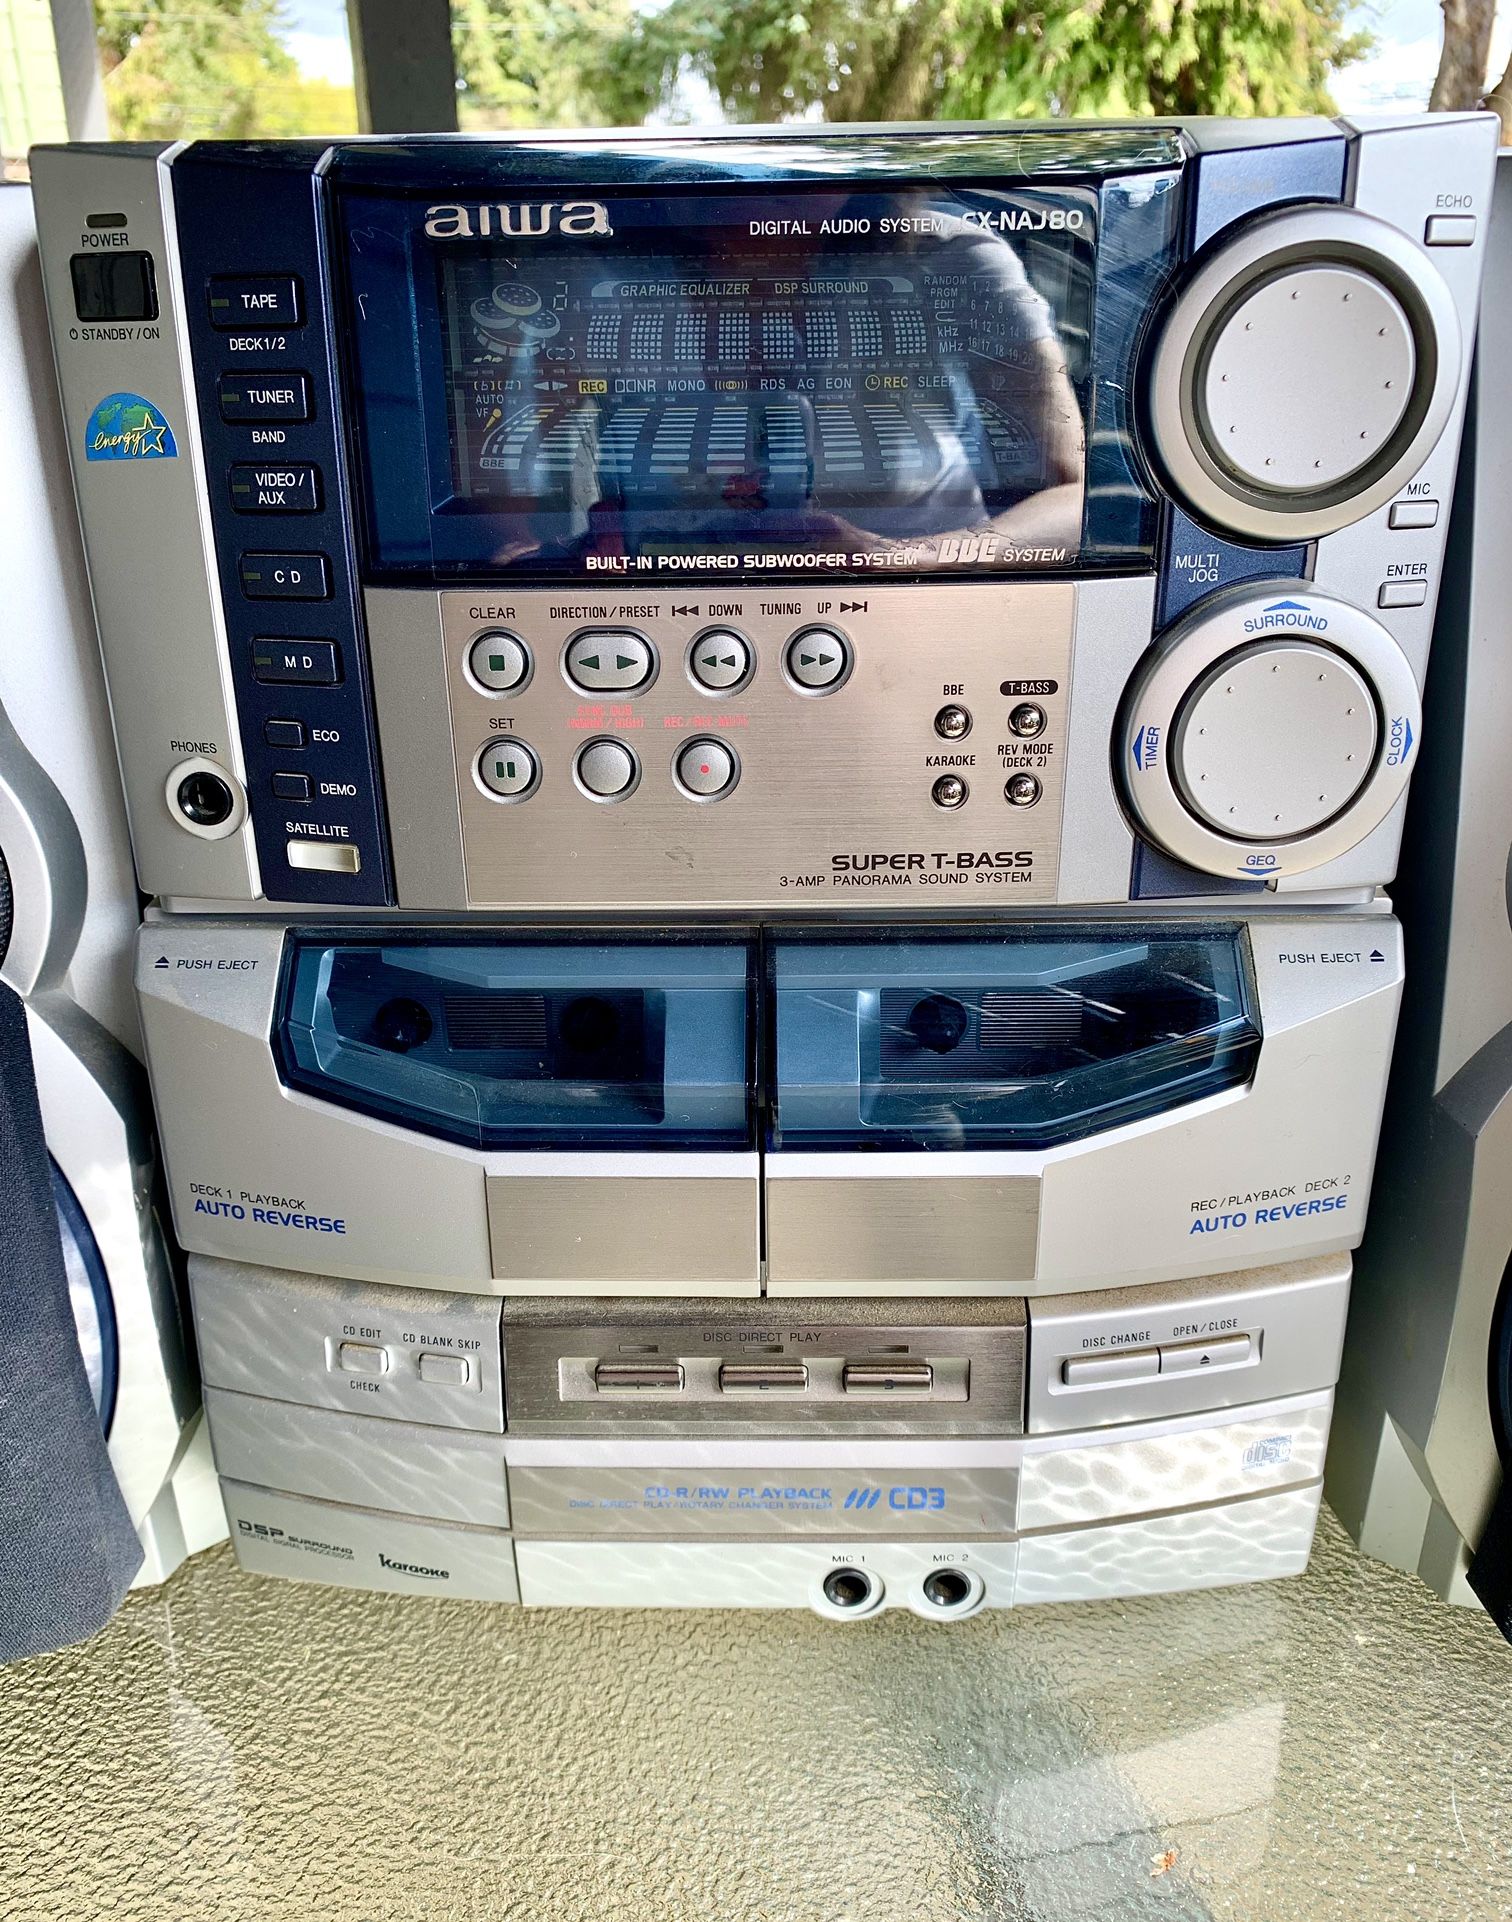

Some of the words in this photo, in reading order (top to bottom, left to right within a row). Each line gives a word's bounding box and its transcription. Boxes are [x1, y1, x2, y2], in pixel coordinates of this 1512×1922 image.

[1436, 194, 1473, 208] ECHO
[424, 201, 614, 239] aiwa
[749, 220, 812, 237] DIGITAL
[819, 218, 871, 235] AUDIO
[879, 217, 944, 233] SYSTEM
[81, 233, 130, 247] POWER
[923, 275, 967, 285] RANDOM
[620, 284, 677, 297] GRAPHIC
[680, 283, 751, 296] EQUALIZER
[774, 283, 799, 294] DSP
[801, 281, 869, 294] SURROUND
[930, 287, 958, 297] PRGM
[241, 294, 278, 309] TAPE
[934, 299, 955, 309] EDIT
[937, 326, 959, 338] kHz
[938, 341, 964, 354] MHz
[581, 381, 605, 393] REC
[667, 380, 706, 392] MONO
[760, 378, 786, 390] RDS
[797, 378, 815, 390] AG
[825, 377, 852, 389] EON
[883, 376, 909, 388] REC
[918, 375, 957, 388] SLEEP
[247, 389, 295, 404] TUNER
[475, 394, 504, 405] AUTO
[475, 407, 488, 418] VF
[252, 430, 286, 444] BAND
[482, 459, 505, 468] BBE
[1407, 482, 1431, 496] MIC
[258, 491, 286, 505] AUX
[938, 538, 1001, 563] BBE
[1003, 548, 1067, 562] SYSTEM
[585, 555, 653, 570] BUILT-IN
[657, 555, 739, 569] POWERED
[743, 553, 847, 569] SUBWOOFER
[851, 552, 918, 566] SYSTEM
[1175, 554, 1220, 569] MULTI
[1188, 569, 1219, 583] JOG
[1386, 563, 1428, 577] ENTER
[469, 607, 516, 620] CLEAR
[708, 604, 743, 617] DOWN
[760, 603, 802, 616] TUNING
[817, 602, 832, 614] UP
[1243, 613, 1329, 633] SURROUND
[942, 684, 965, 696] BBE
[1008, 682, 1050, 694] T-BASS
[488, 717, 516, 730] SET
[312, 729, 340, 743] ECO
[1386, 716, 1403, 766] CLOCK
[170, 740, 218, 754] PHONES
[997, 744, 1019, 755] REV
[1022, 743, 1054, 755] MODE
[1145, 726, 1161, 770] TIMER
[926, 754, 976, 767] KARAOKE
[1002, 756, 1033, 769] (DECK
[1036, 755, 1047, 768] 2)
[320, 783, 357, 797] DEMO
[286, 821, 350, 838] SATELLITE
[831, 854, 925, 872] SUPER
[931, 851, 1033, 869] T-BASS
[1245, 854, 1277, 866] GEQ
[779, 875, 826, 888] 3-AMP
[832, 874, 912, 886] PANORAMA
[918, 873, 969, 885] SOUND
[975, 871, 1032, 884] SYSTEM
[176, 959, 213, 970] PUSH
[217, 959, 259, 971] EJECT
[1278, 953, 1316, 964] PUSH
[1320, 952, 1361, 964] EJECT
[1305, 1177, 1339, 1193] DECK
[1343, 1174, 1351, 1186] 2
[189, 1182, 222, 1198] DECK
[226, 1188, 232, 1199] 1
[240, 1191, 306, 1211] PLAYBACK
[194, 1198, 245, 1220] AUTO
[252, 1207, 346, 1234] REVERSE
[1189, 1212, 1247, 1235] AUTO
[1254, 1194, 1348, 1224] REVERSE
[342, 1325, 356, 1337] CD
[360, 1326, 382, 1339] EDIT
[703, 1332, 733, 1343] DISC
[738, 1332, 784, 1343] DIRECT
[789, 1332, 822, 1343] PLAY
[402, 1332, 416, 1344] CD
[420, 1334, 453, 1348] BLANK
[458, 1338, 482, 1350] SKIP
[1082, 1335, 1106, 1348] DISC
[1110, 1331, 1151, 1347] CHANGE
[350, 1380, 381, 1393] CHECK
[738, 1487, 833, 1500] PLAYBACK
[888, 1486, 946, 1511] CD3
[237, 1519, 285, 1537] DSP
[288, 1535, 353, 1555] SURROUND
[932, 1554, 958, 1562] MIC
[961, 1554, 969, 1562] 2
[378, 1553, 450, 1579] Karaoke
